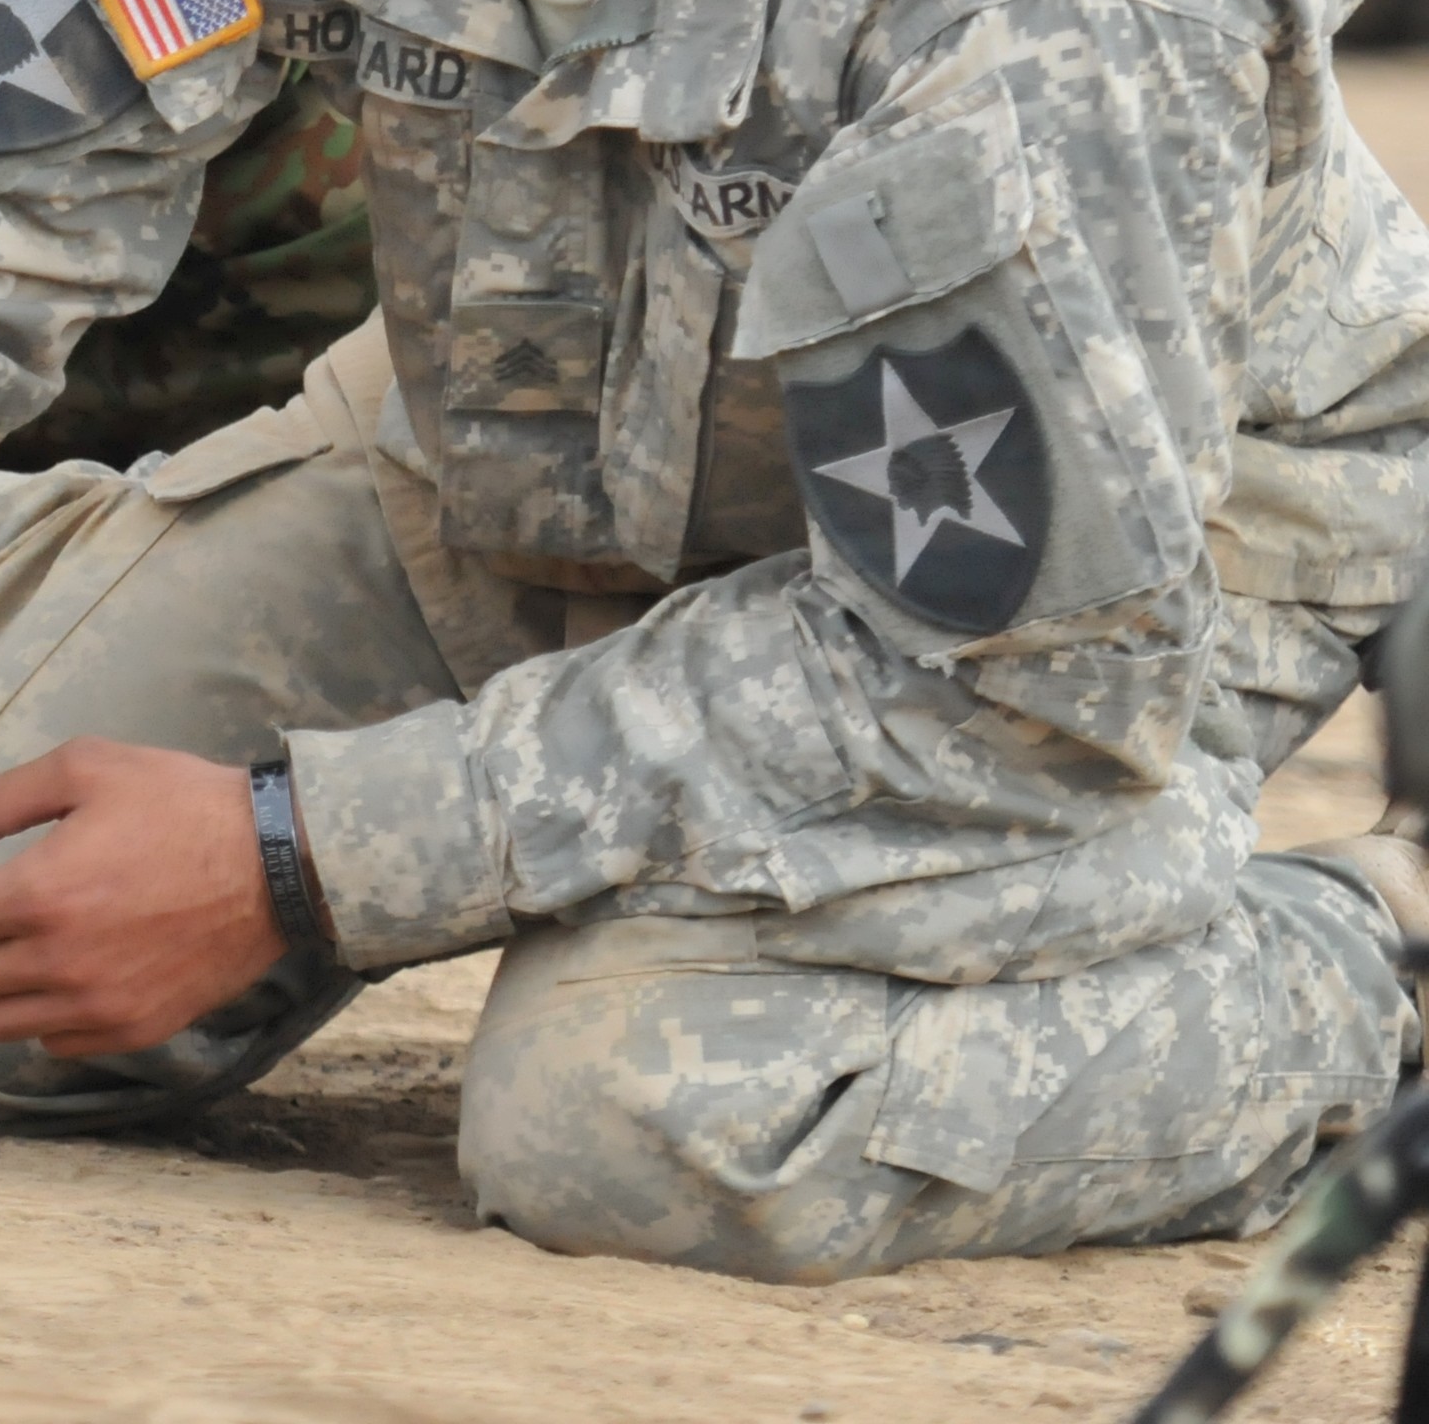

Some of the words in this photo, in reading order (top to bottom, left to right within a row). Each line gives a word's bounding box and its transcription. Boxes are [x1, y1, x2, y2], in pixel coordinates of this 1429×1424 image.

[285, 7, 467, 101] HOARD
[692, 180, 794, 226] ARM
[264, 844, 283, 874] JULY
